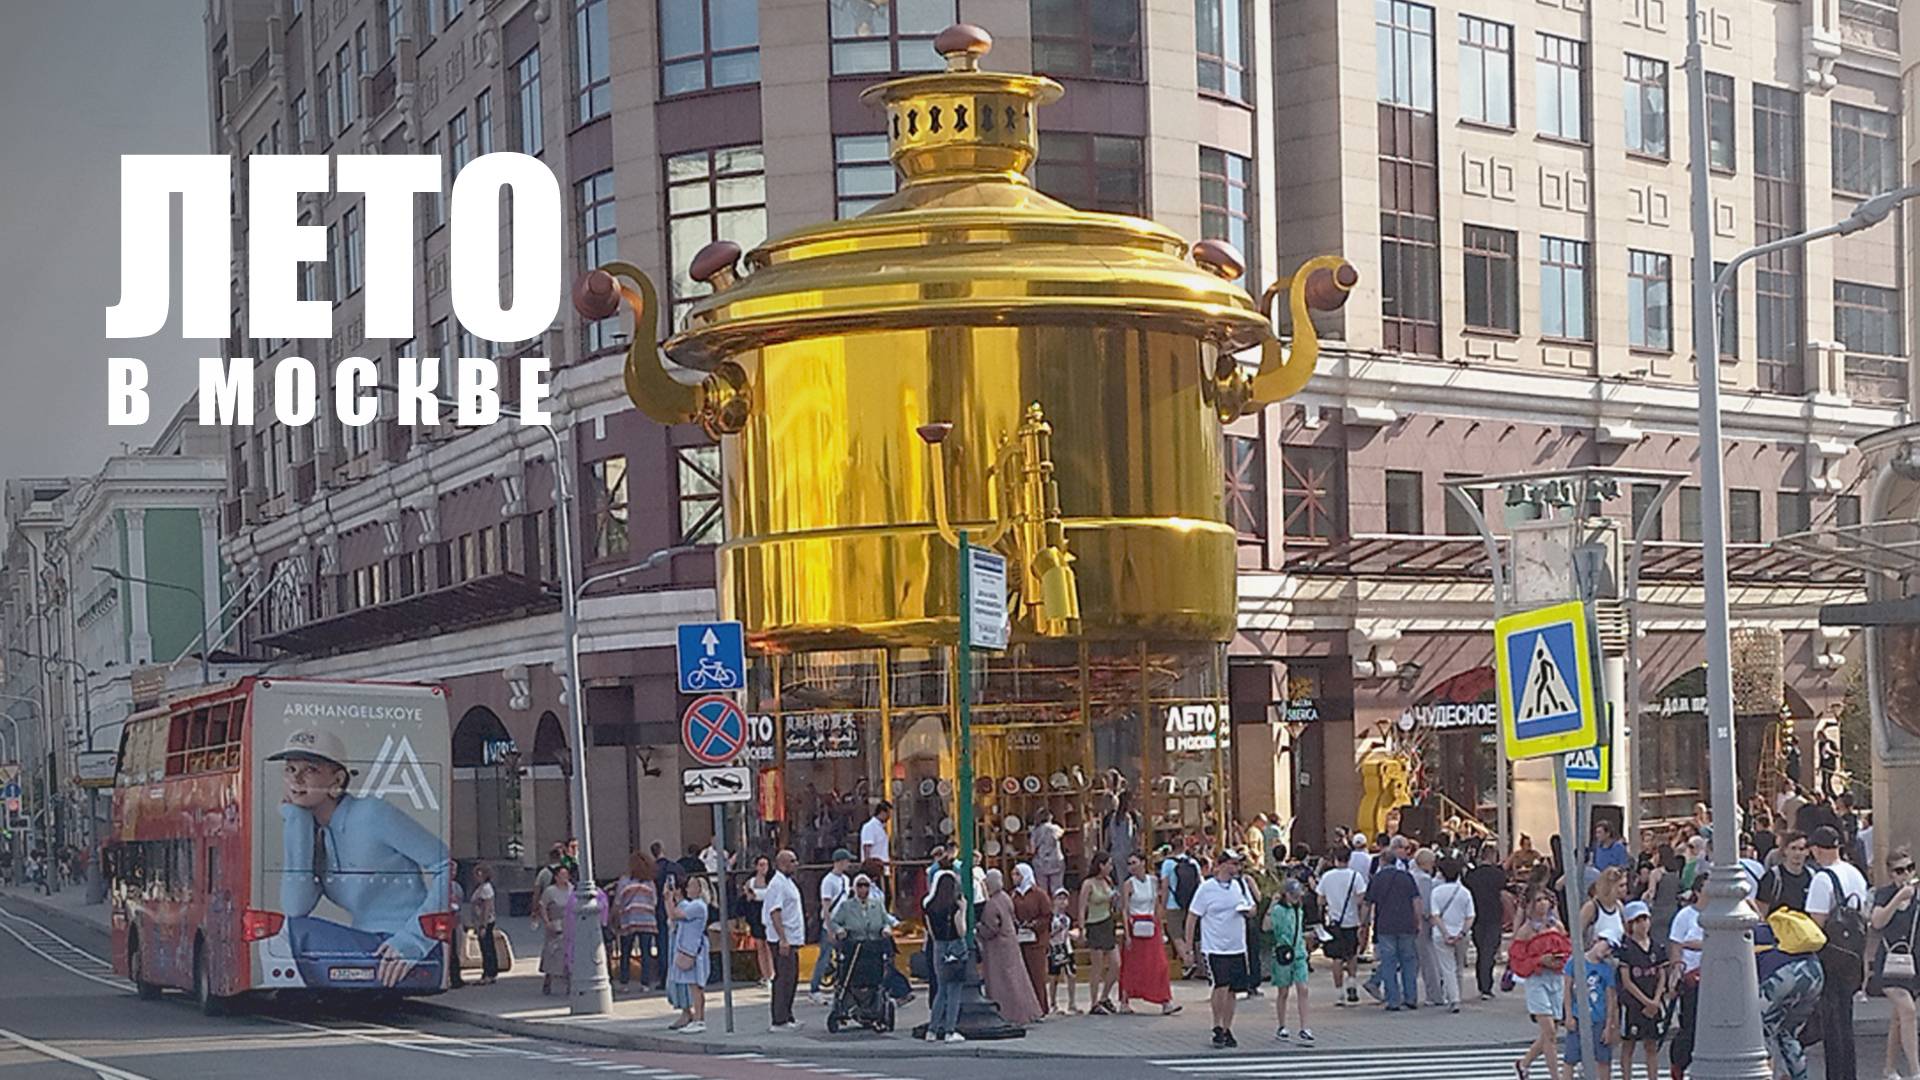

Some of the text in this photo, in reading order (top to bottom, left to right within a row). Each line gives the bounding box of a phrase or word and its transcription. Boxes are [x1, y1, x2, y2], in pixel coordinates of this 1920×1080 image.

[283, 703, 423, 721] ARKHANGELSKOYE
[1166, 704, 1217, 733] ЛЕТО
[1415, 704, 1497, 728] ЧУДЕСНОЕ
[747, 716, 773, 741] ТО
[1166, 737, 1175, 751] В
